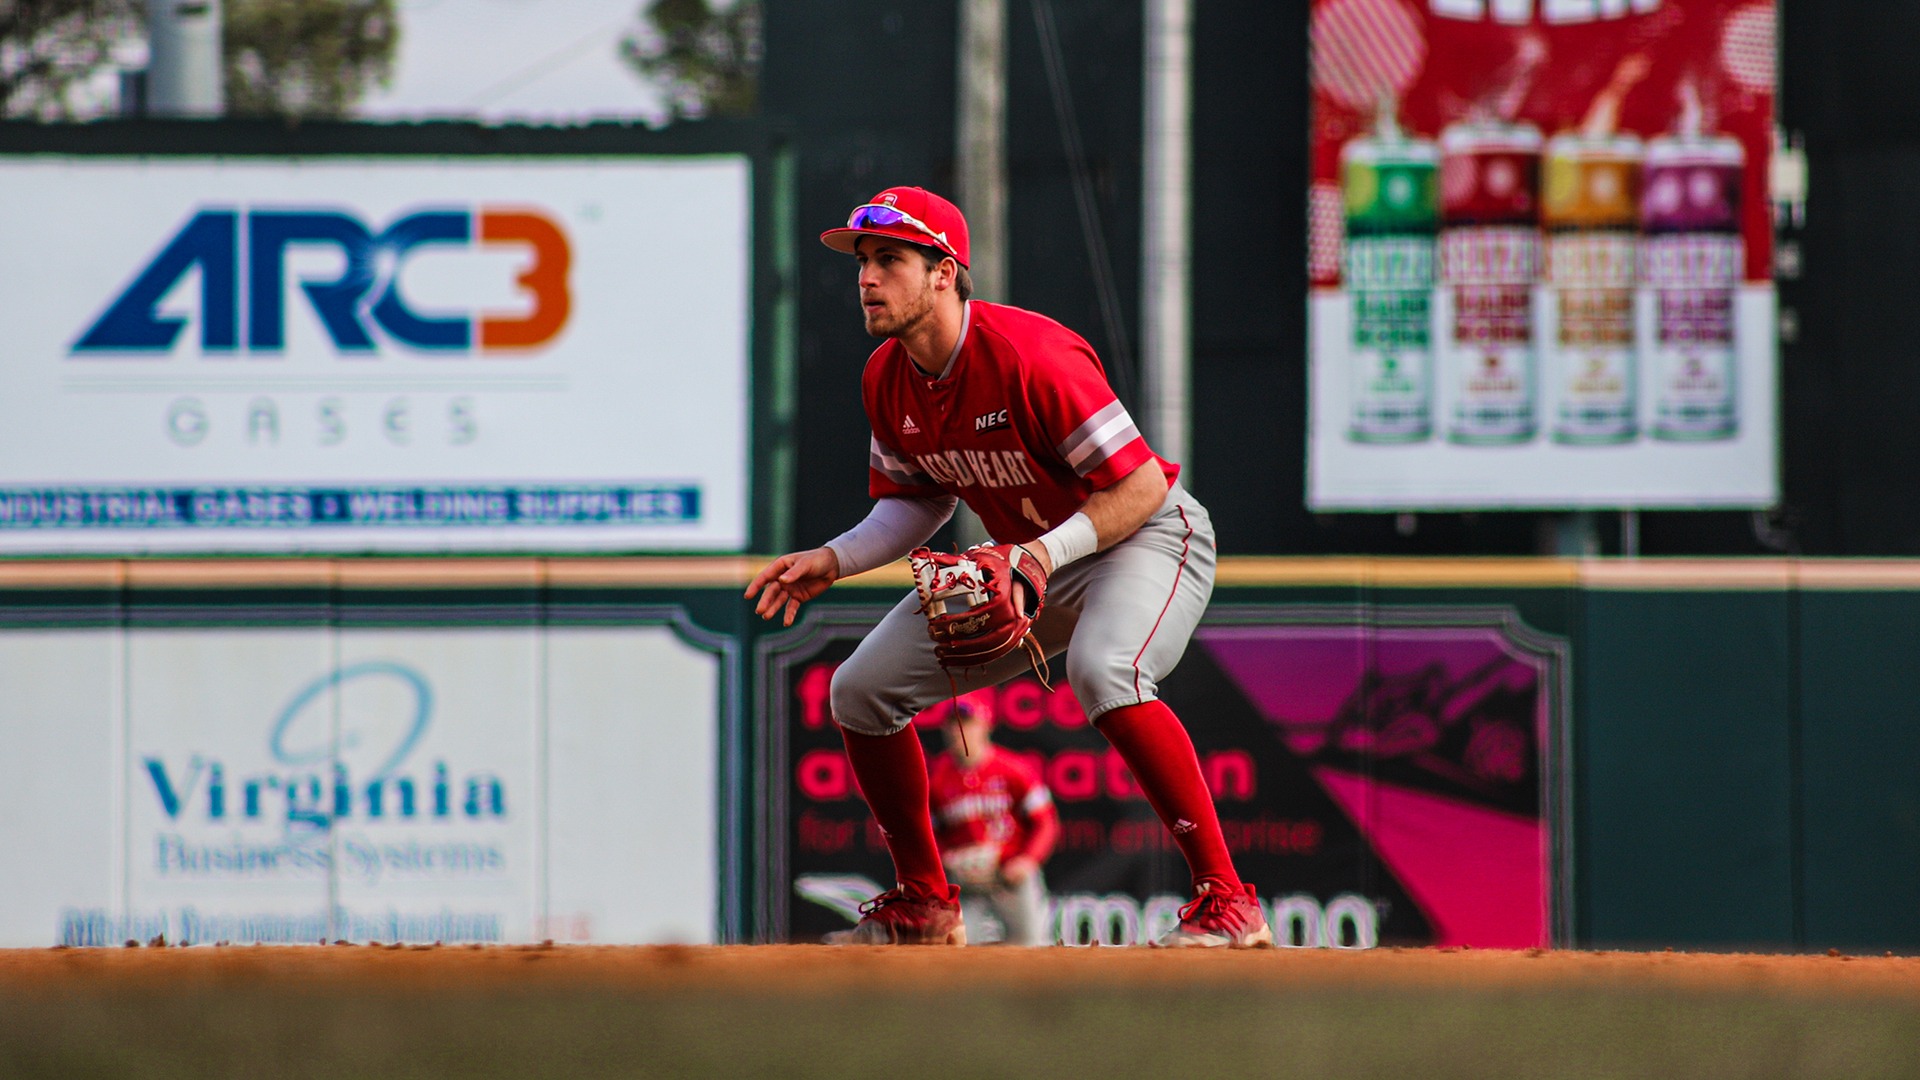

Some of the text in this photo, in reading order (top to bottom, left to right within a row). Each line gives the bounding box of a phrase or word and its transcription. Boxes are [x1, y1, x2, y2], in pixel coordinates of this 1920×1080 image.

[67, 207, 573, 356] ARC3
[167, 398, 478, 445] GASES
[975, 408, 1008, 431] NEC
[963, 449, 1037, 488] HEART
[194, 490, 309, 523] GASES
[350, 490, 511, 523] WELDING
[145, 757, 507, 840] Virginia
[157, 832, 505, 884] Business Systems
